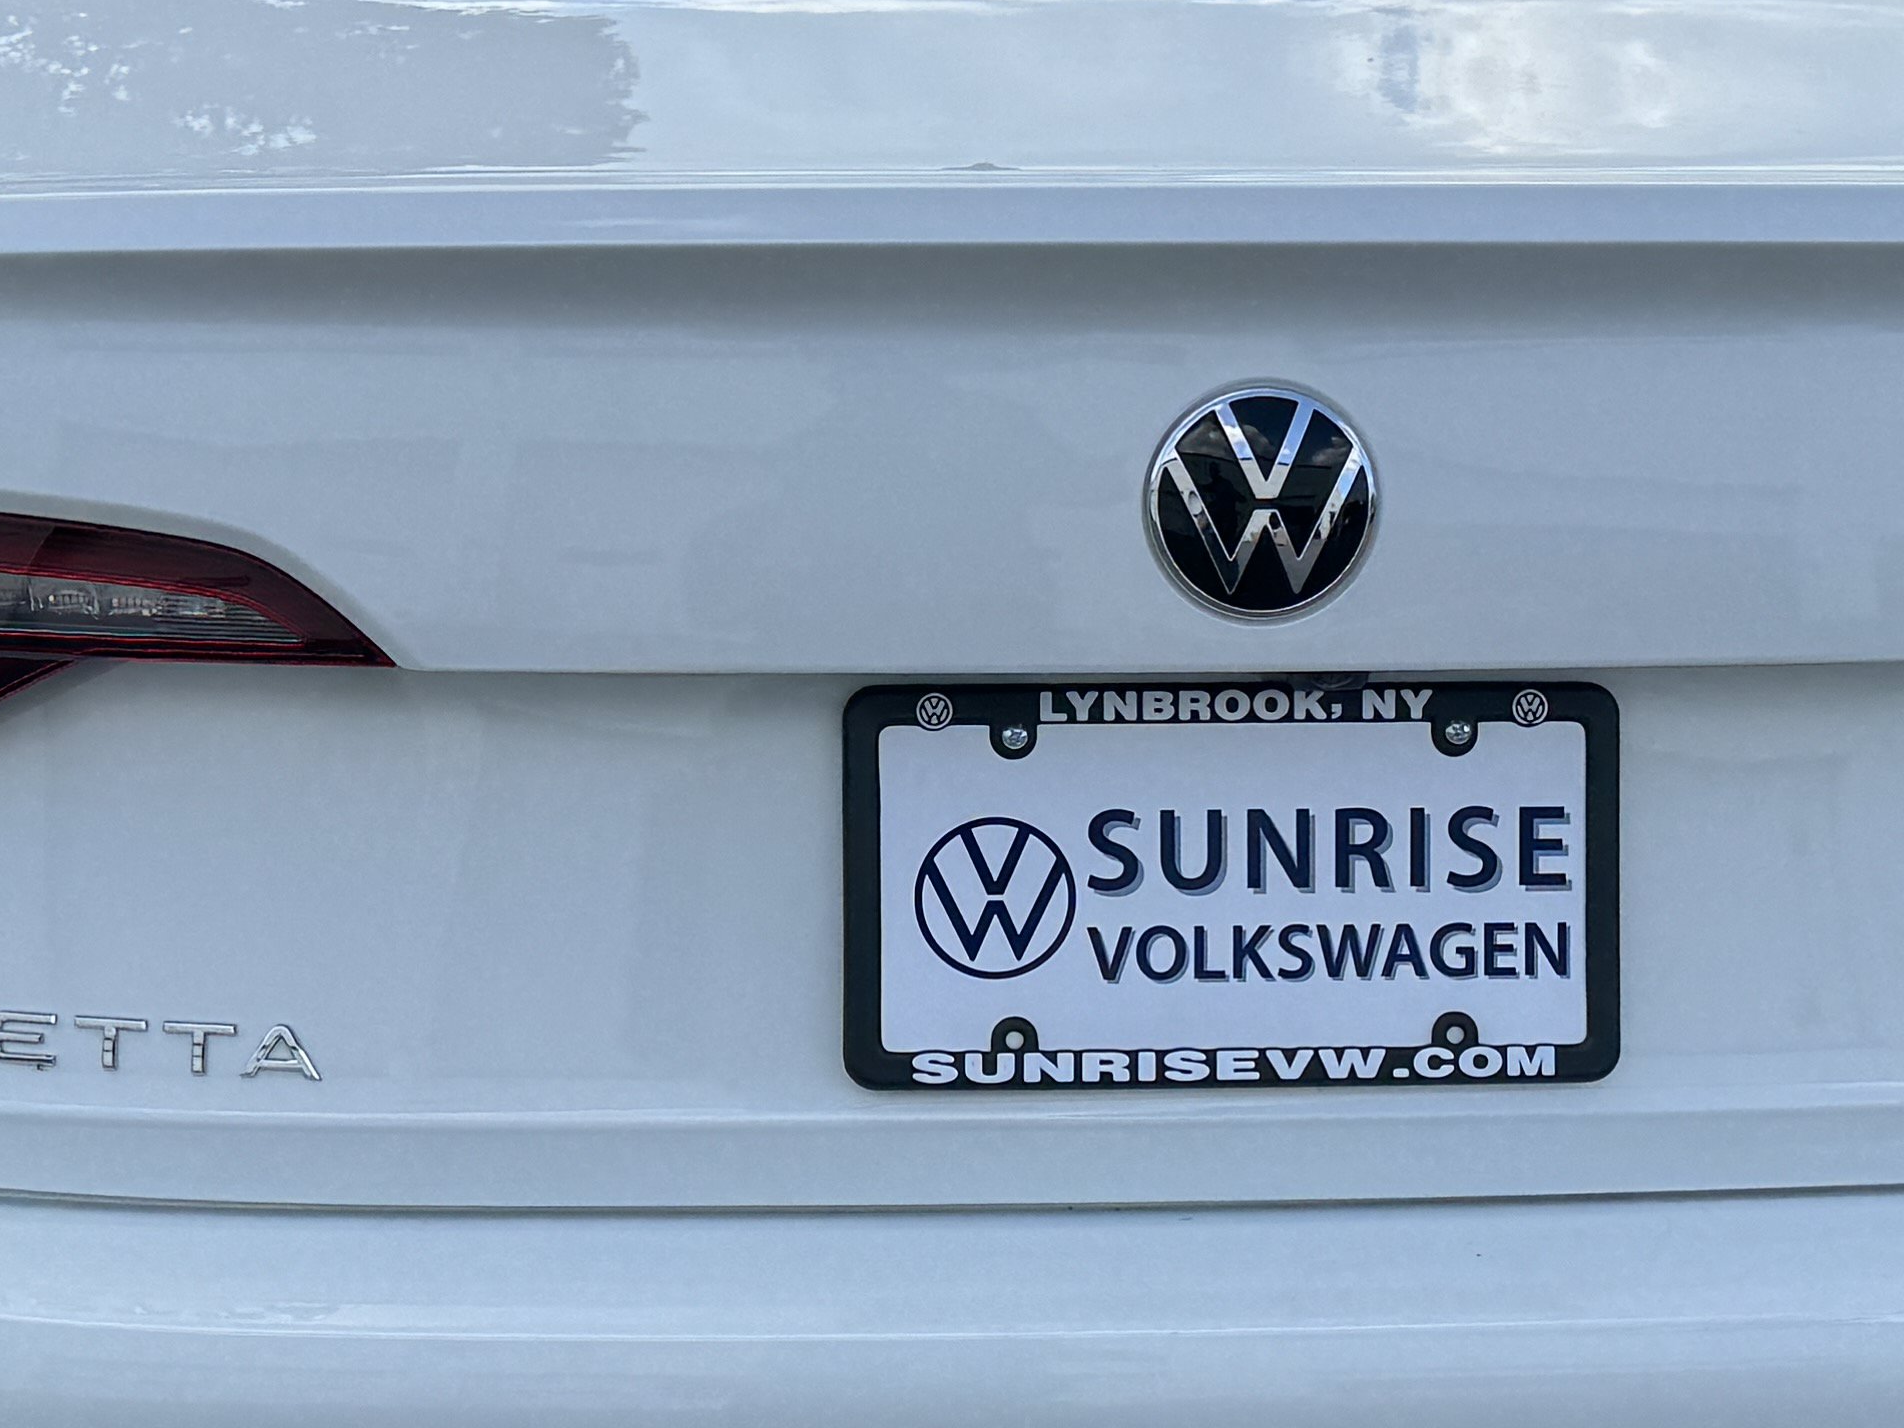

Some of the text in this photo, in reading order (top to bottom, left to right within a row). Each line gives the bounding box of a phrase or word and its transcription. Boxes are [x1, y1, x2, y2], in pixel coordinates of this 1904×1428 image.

[1149, 383, 1377, 620] VW
[916, 692, 953, 729] VW
[1361, 688, 1433, 719] NY
[1512, 689, 1548, 724] VW
[1086, 805, 1572, 893] SUNRISE
[914, 816, 1077, 979] VW
[1087, 922, 1571, 983] VOLKSWAGEN
[911, 1045, 1557, 1085] SUNRISEVW.COM
